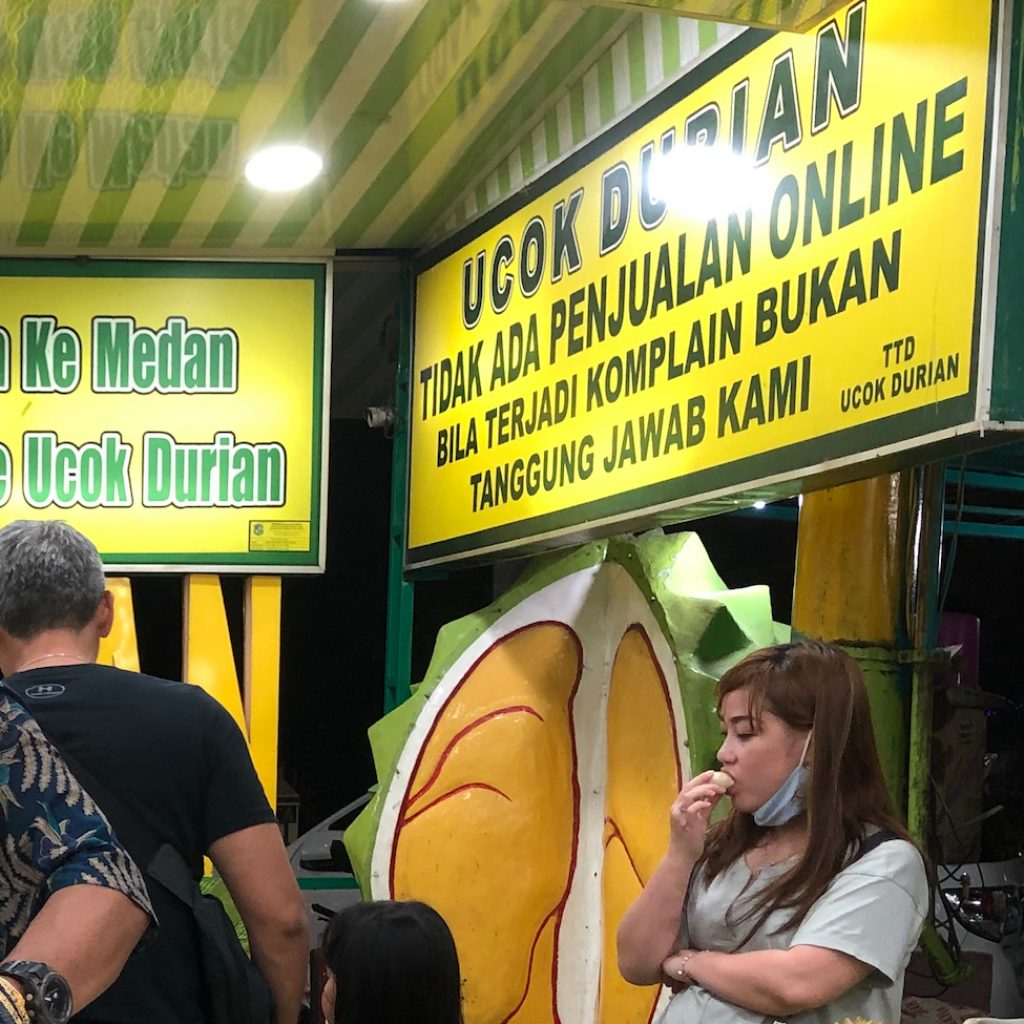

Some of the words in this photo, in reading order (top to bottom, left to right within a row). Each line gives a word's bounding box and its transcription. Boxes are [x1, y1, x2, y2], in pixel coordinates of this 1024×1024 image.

[420, 340, 484, 421] TIDAK
[490, 313, 540, 393] ADA
[549, 208, 753, 366] PENJUALAN
[769, 76, 968, 260] ONLINE
[462, 188, 584, 330] UCOK
[19, 314, 82, 395] Ke
[90, 315, 239, 395] Medan
[437, 418, 478, 468] BILA
[485, 374, 578, 450] TERJADI
[586, 301, 743, 412] KOMPLAIN
[755, 229, 902, 347] BUKAN
[840, 376, 886, 413] UCOK
[891, 352, 960, 398] DURIAN
[882, 335, 916, 369] TTD
[22, 430, 133, 509] Ucok
[141, 430, 288, 508] Durian
[470, 434, 594, 514] TANGGUNG
[603, 394, 706, 474] JAWAB
[717, 355, 812, 438] KAMI
